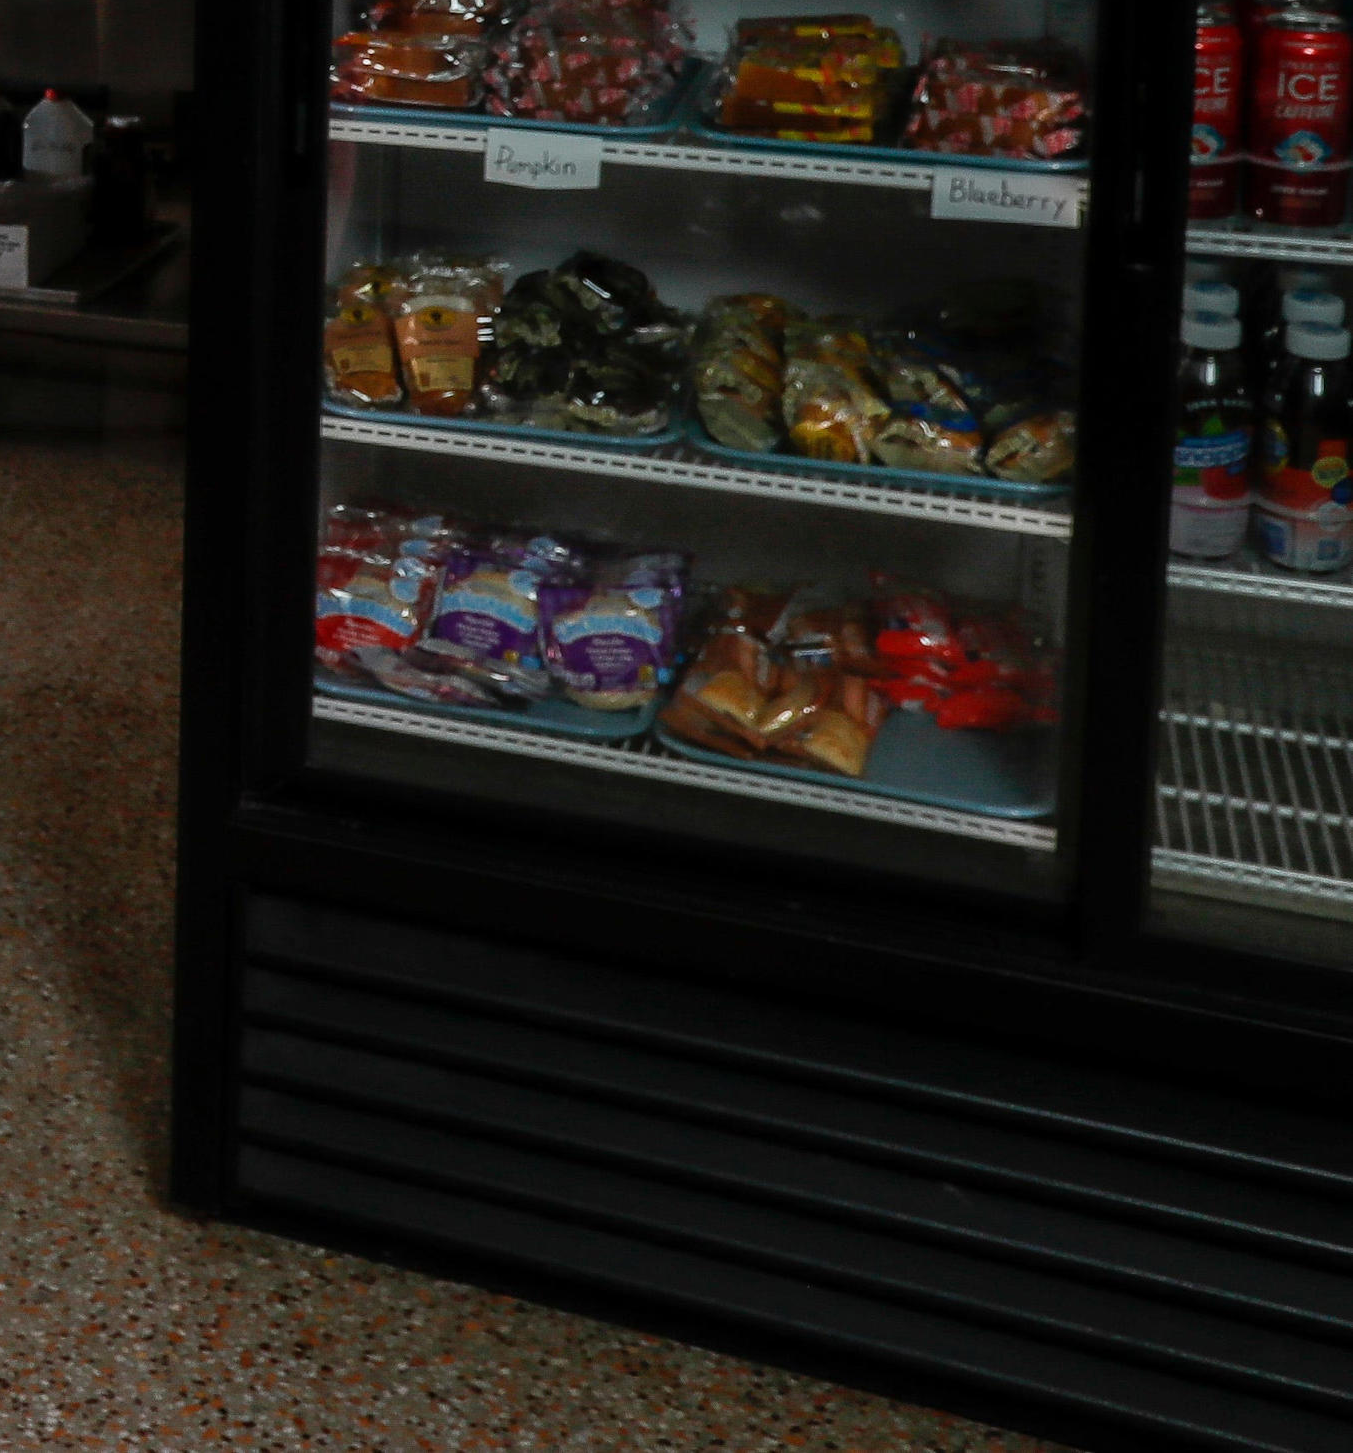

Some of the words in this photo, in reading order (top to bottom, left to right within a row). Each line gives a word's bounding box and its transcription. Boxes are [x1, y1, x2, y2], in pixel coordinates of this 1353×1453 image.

[1277, 71, 1340, 101] ICE
[494, 145, 577, 180] Pumpkin
[949, 177, 1067, 220] Blueberry
